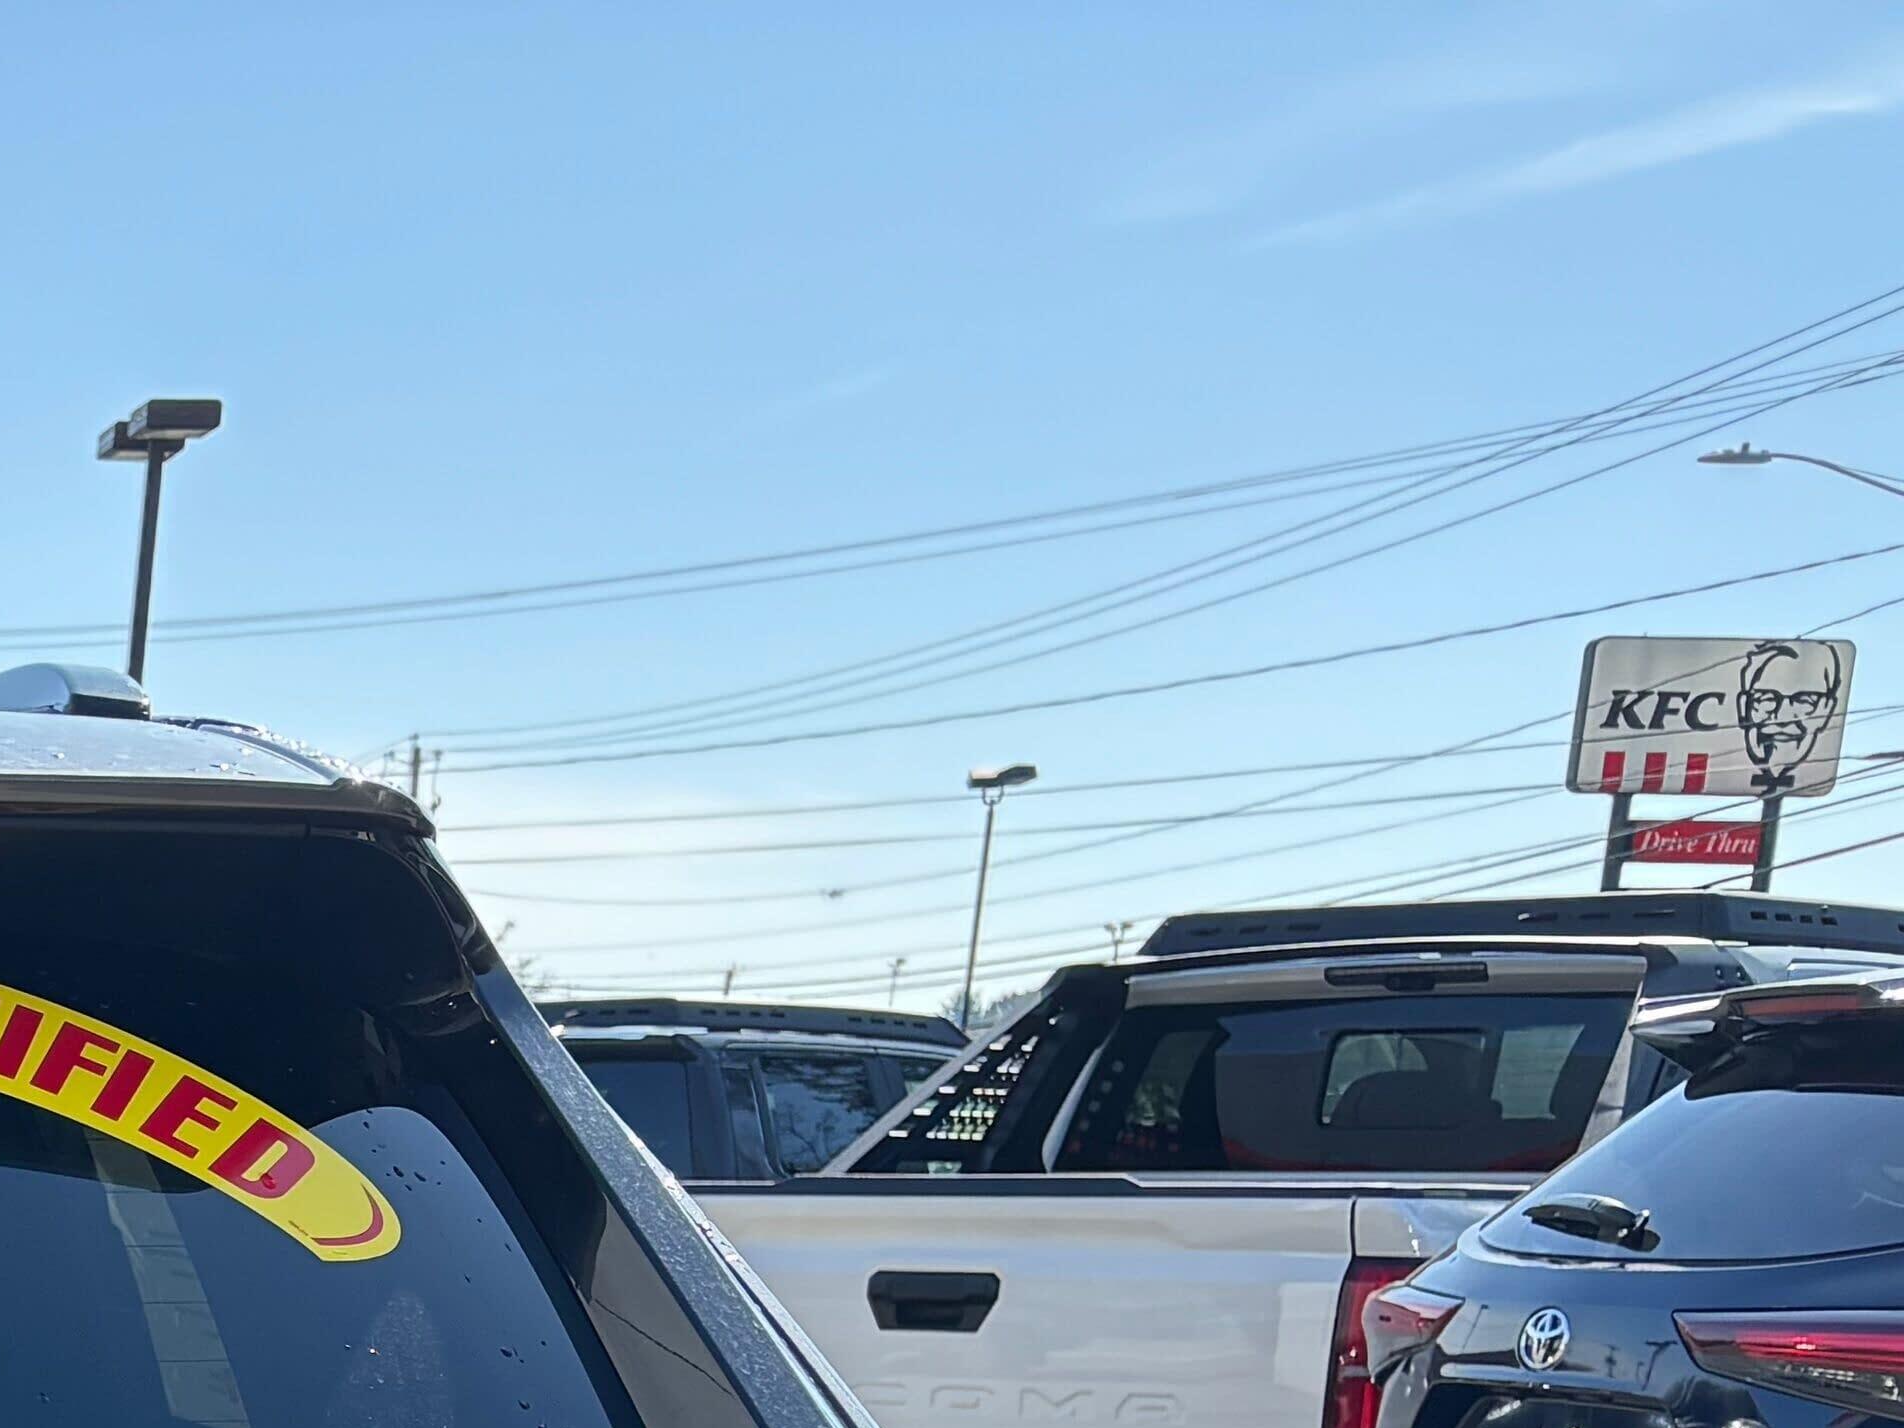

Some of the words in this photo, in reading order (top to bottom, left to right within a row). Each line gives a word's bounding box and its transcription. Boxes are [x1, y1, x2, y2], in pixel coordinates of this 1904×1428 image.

[1600, 689, 1725, 730] KFC
[1640, 830, 1698, 853] Drive
[1706, 831, 1756, 854] Thru
[850, 1381, 1186, 1426] COMA
